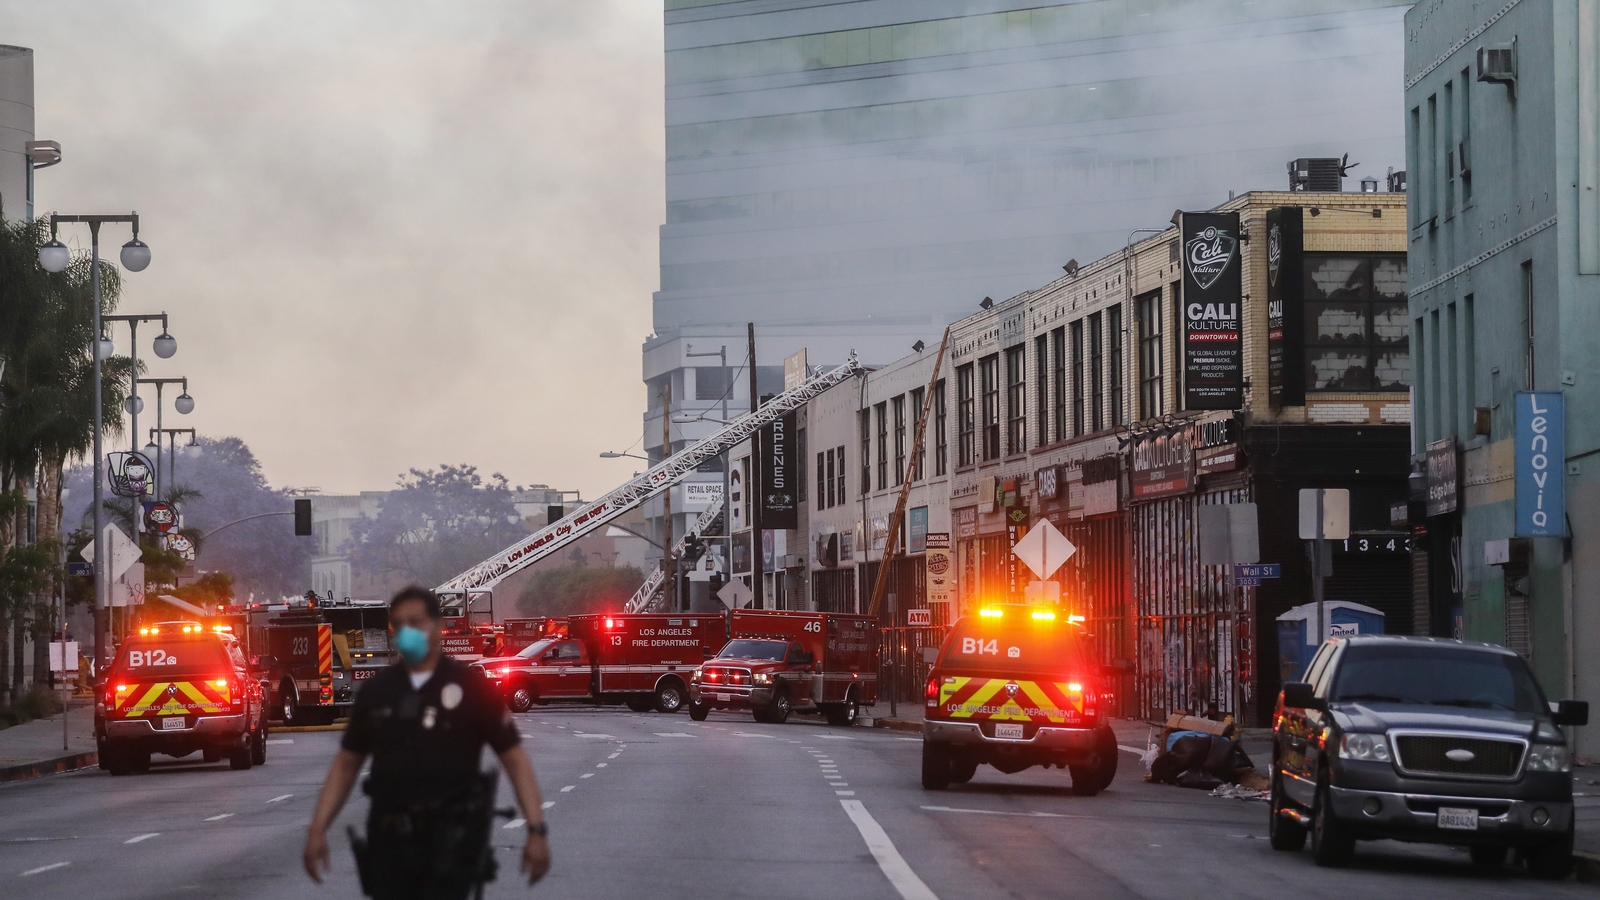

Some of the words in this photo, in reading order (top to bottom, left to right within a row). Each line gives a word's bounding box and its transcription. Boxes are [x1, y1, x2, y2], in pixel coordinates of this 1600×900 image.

[1191, 237, 1228, 264] Cali
[1188, 303, 1236, 320] CALI
[1269, 300, 1283, 318] CALI
[1188, 321, 1236, 330] KULTURE
[651, 471, 667, 484] 33
[1038, 468, 1056, 497] DABS
[507, 550, 523, 563] LOS
[523, 532, 554, 555] ANGELES
[556, 522, 572, 537] City
[573, 511, 588, 527] FIRE
[589, 503, 609, 519] DEPT.
[1242, 567, 1259, 576] Wall
[1263, 567, 1273, 576] St
[909, 613, 929, 622] ATM
[804, 621, 821, 633] 46
[293, 637, 308, 655] 233
[610, 636, 622, 646] 13
[828, 639, 836, 650] 46
[962, 637, 998, 655] B14
[130, 650, 166, 667] B12
[966, 705, 1001, 715] ANGELES
[1004, 707, 1021, 715] FIRE
[1024, 708, 1075, 718] DEPARTMENT
